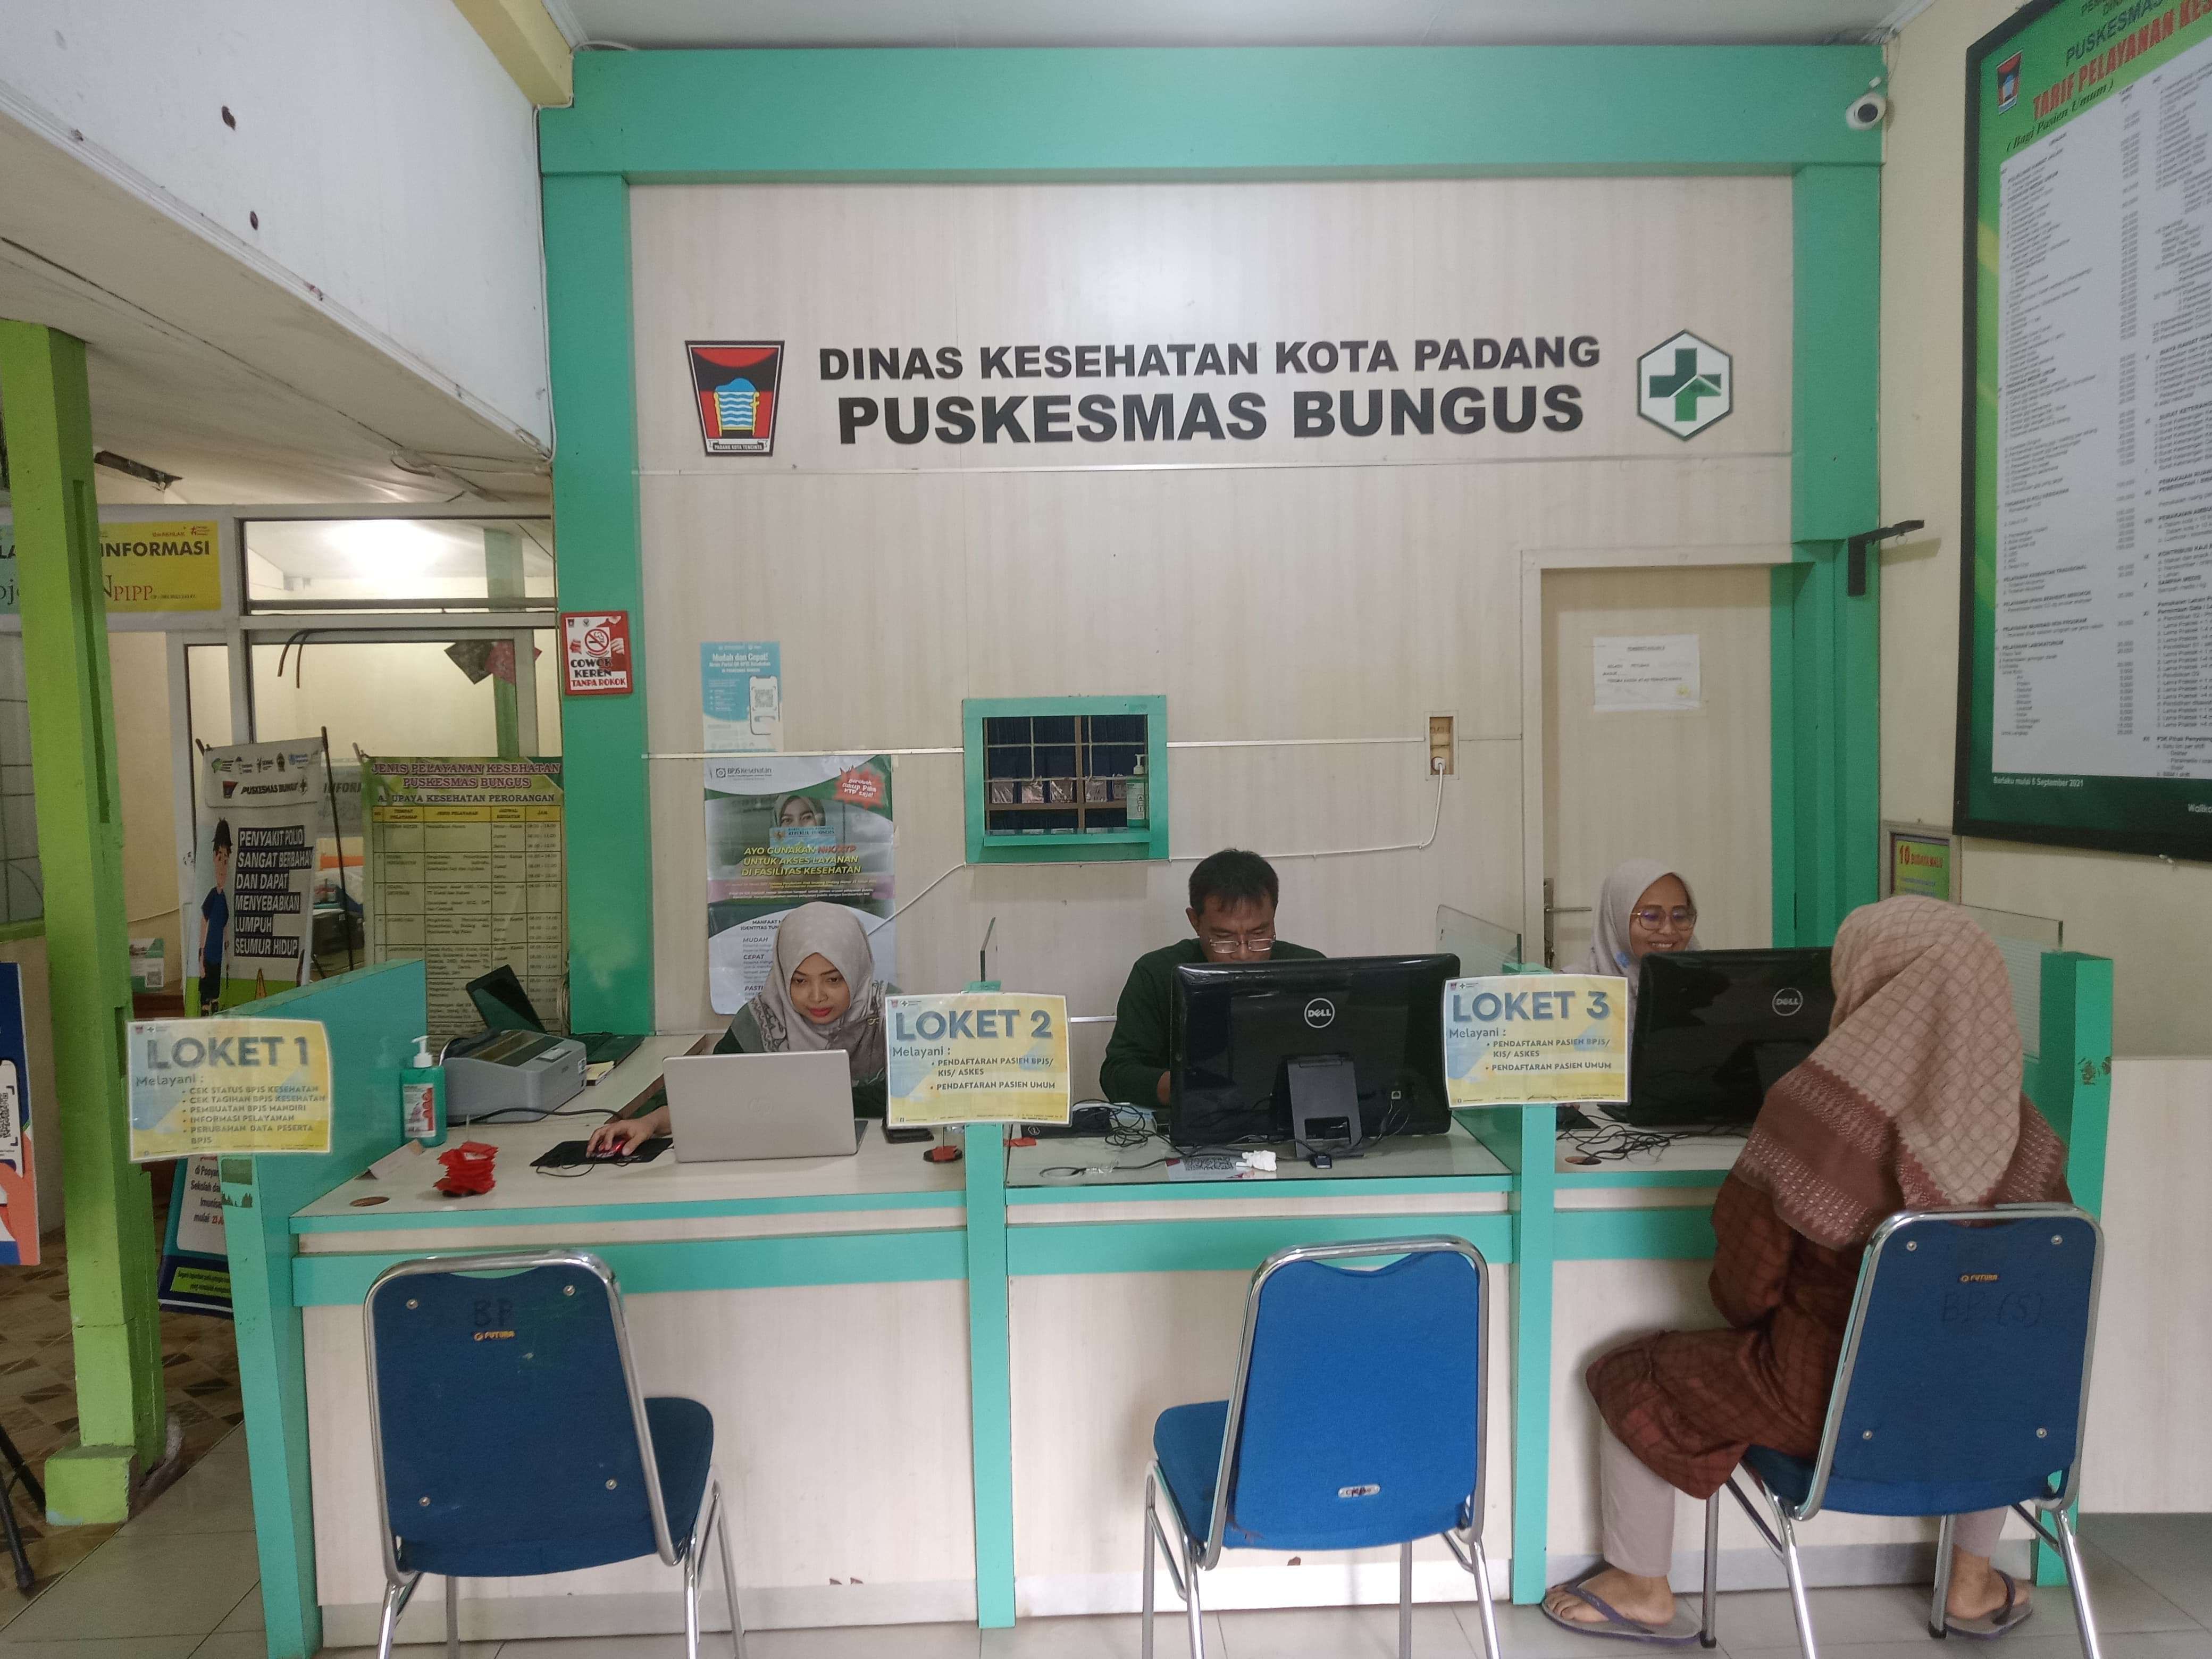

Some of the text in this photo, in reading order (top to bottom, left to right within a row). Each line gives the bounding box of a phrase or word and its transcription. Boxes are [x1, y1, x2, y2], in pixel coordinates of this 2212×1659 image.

[2033, 72, 2074, 120] TARIF
[819, 336, 1600, 381] DINAS KESEHATAN KOTA PADANG
[838, 384, 1584, 445] PUSKESMAS BUNGUS
[100, 540, 210, 557] INFORMASI
[113, 585, 153, 601] PIPP
[570, 658, 613, 668] COWOK
[574, 669, 611, 678] KEREN
[599, 677, 626, 686] ROKOK
[373, 763, 562, 775] JENIS PELAYANAN KESEHATAN
[403, 777, 531, 789] PUSKESMAS BUNGUS
[426, 794, 485, 803] KESEHATAN
[488, 794, 555, 802] PERORANGAN
[239, 828, 304, 847] PENYAKIT POLIO
[744, 847, 815, 856] AYO GUNAKAN
[238, 851, 277, 869] SANGAT
[743, 857, 777, 866] UNTUK
[812, 856, 859, 864] LAYANAN
[753, 867, 801, 876] FASILITAS
[803, 866, 862, 875] KESEHATAN
[236, 872, 289, 890] DAN DAPAT
[235, 894, 300, 911] MENYEBABKAN
[235, 917, 272, 933] LUMPUH
[235, 937, 298, 956] SEUMUR HIDUP
[1453, 991, 1611, 1022] LOKET 3
[1308, 1008, 1332, 1018] DELL
[895, 1009, 1053, 1041] LOKET 2
[1449, 1027, 1499, 1040] Melayani
[1493, 1039, 1554, 1048] PENDAFTARAN
[1586, 1038, 1611, 1048] BPJS/
[147, 1036, 309, 1069] LOKET 1
[892, 1046, 944, 1059] Melayani
[1493, 1050, 1511, 1060] KIS/
[937, 1057, 998, 1067] PENDAFTARAN
[1031, 1057, 1054, 1067] BPJS/
[1492, 1063, 1553, 1071] PENDAFTARAN
[938, 1069, 956, 1078] KIS/
[136, 1075, 196, 1087] Melayani
[936, 1082, 997, 1091] PENDAFTARAN
[190, 1125, 246, 1134] PERUBAHAN
[190, 1136, 213, 1145] BPJS
